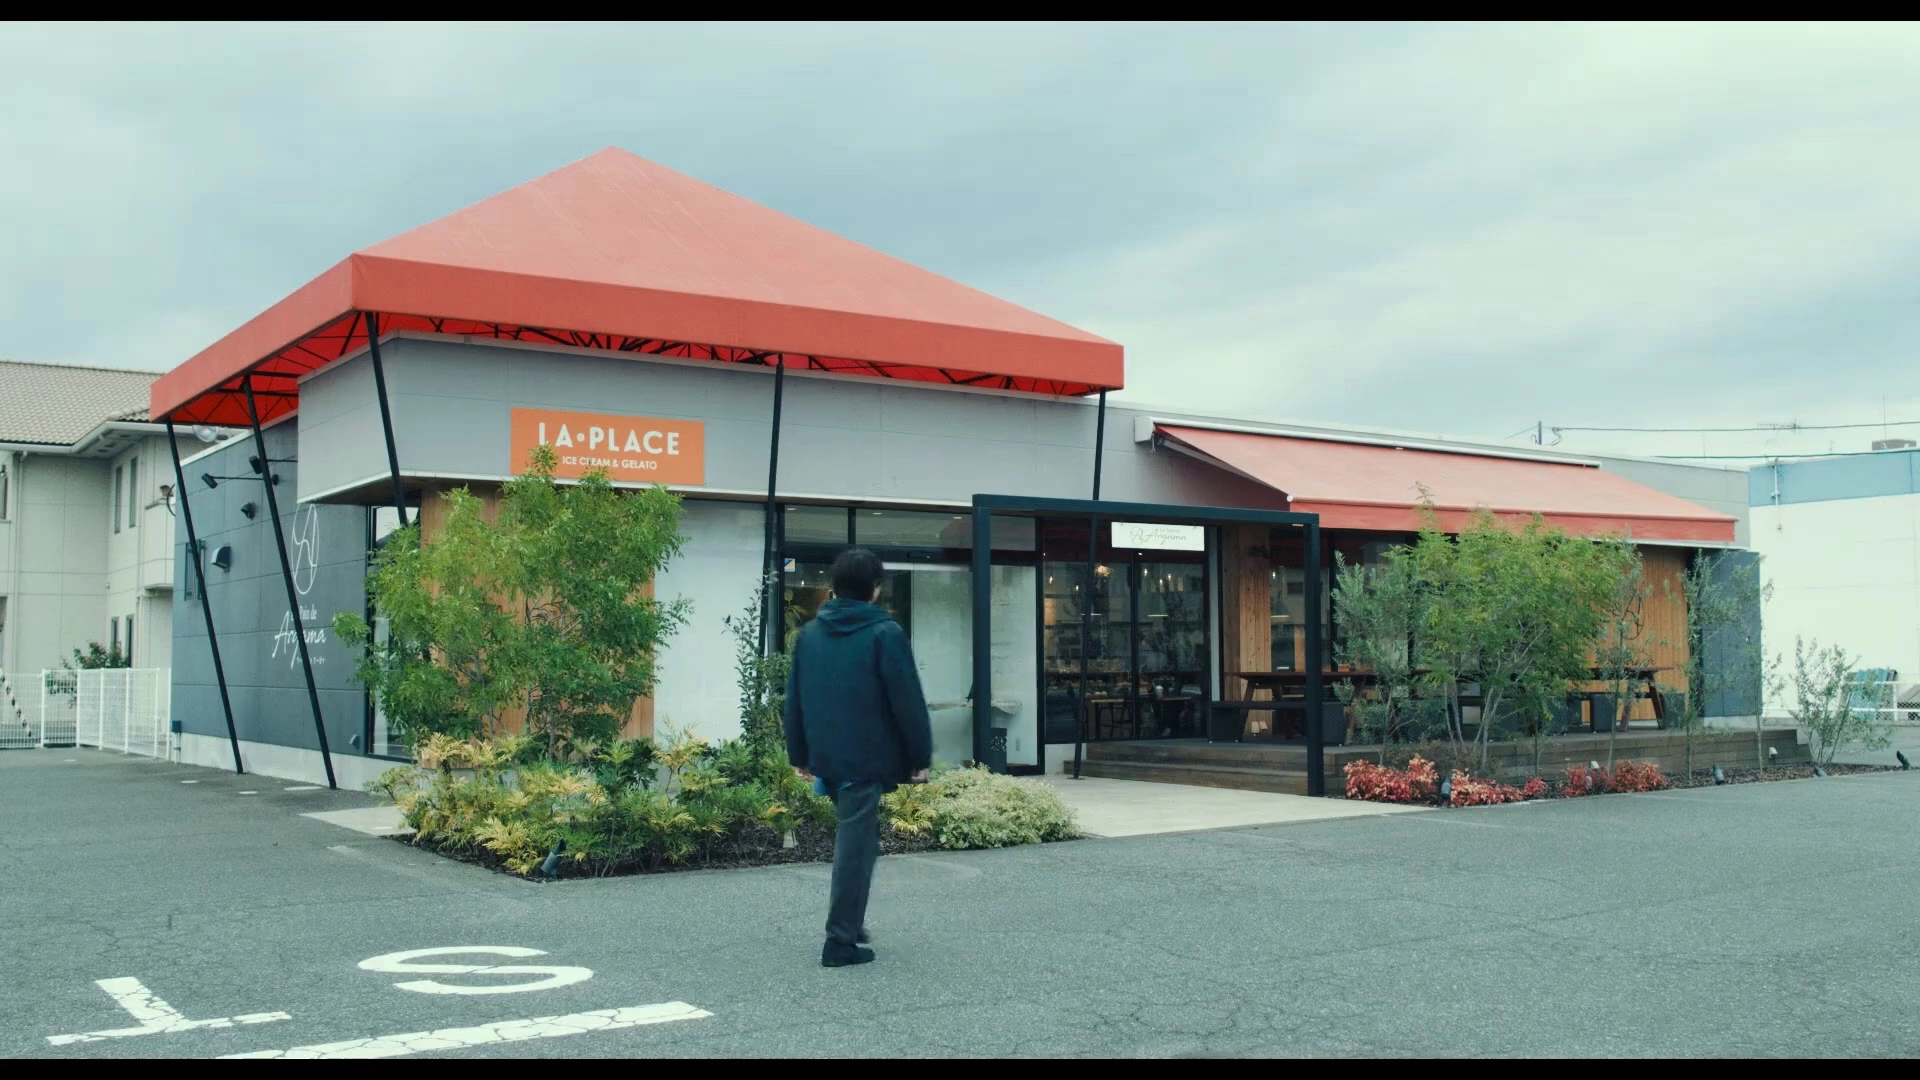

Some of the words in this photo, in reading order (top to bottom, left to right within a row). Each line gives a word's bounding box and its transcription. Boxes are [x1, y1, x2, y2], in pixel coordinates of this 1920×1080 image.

[562, 456, 577, 465] ICE
[612, 459, 619, 468] &
[621, 459, 658, 470] GELATO
